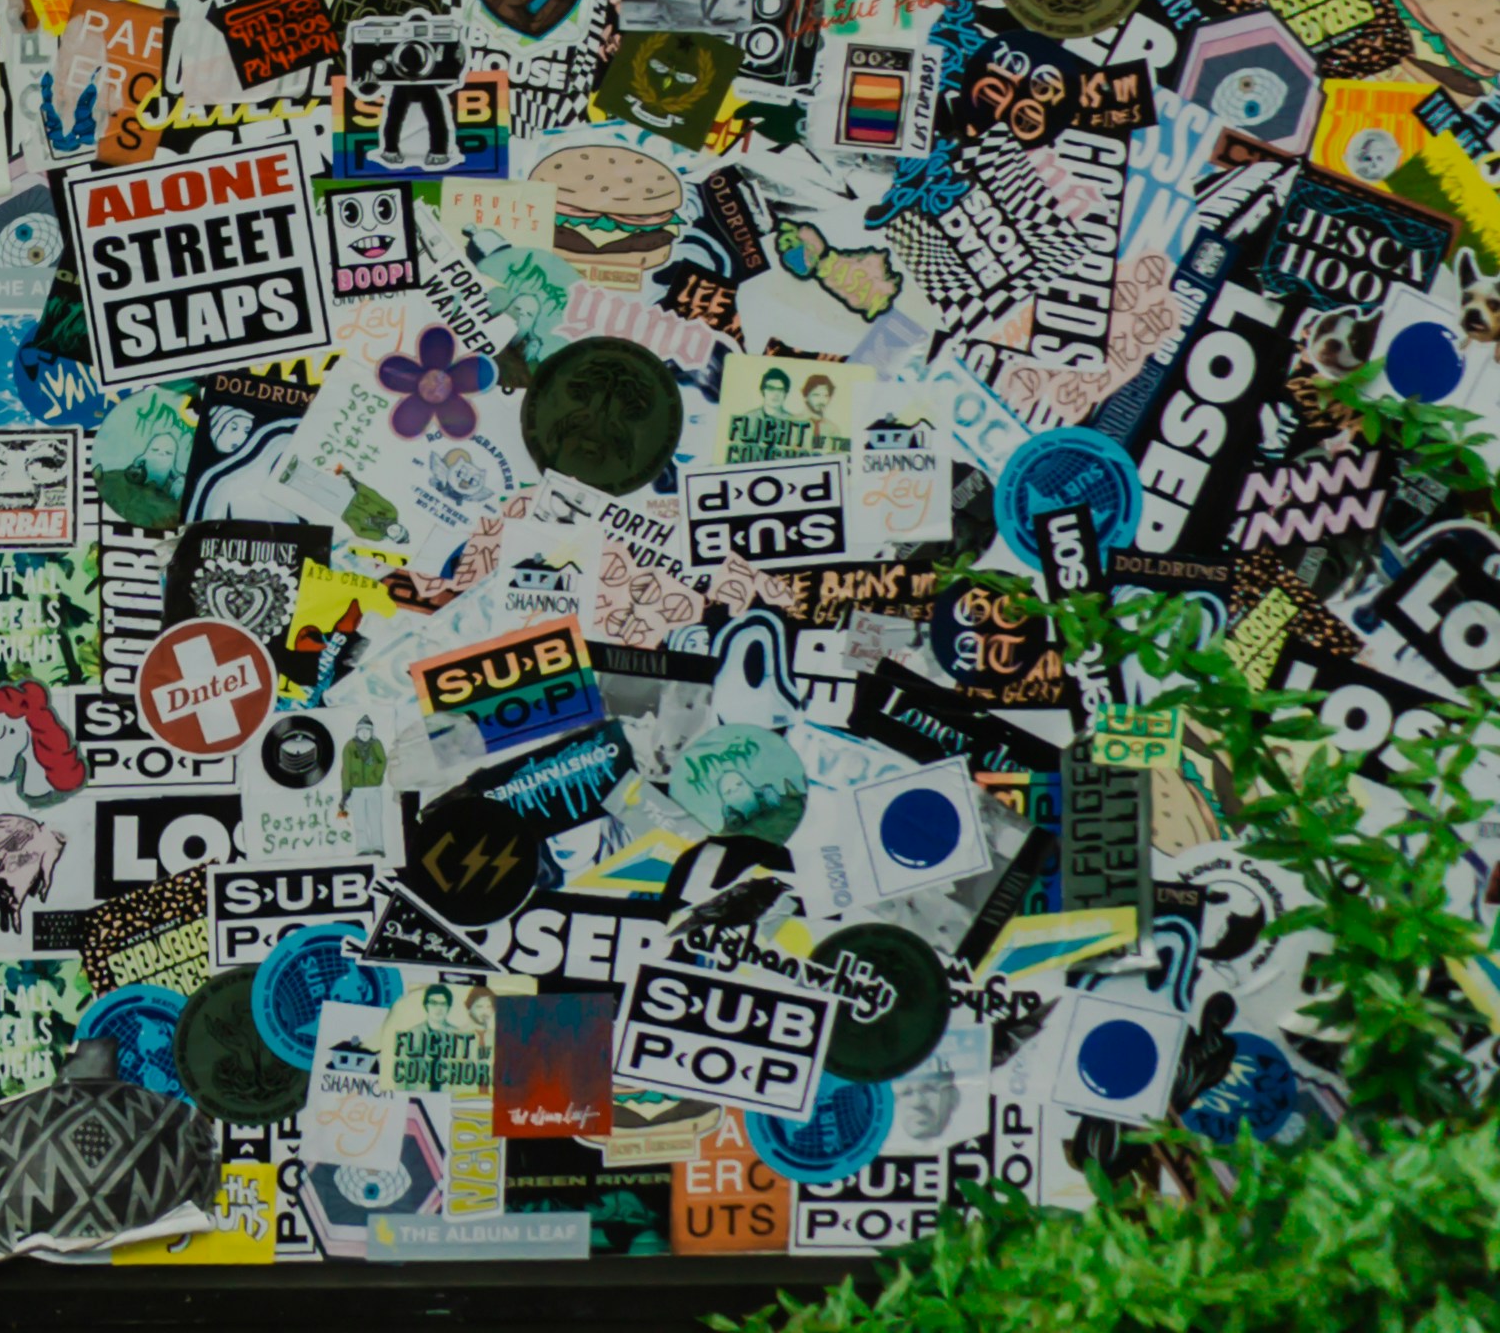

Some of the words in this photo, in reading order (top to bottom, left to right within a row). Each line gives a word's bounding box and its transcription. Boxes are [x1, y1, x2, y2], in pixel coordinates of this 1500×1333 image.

[86, 154, 294, 228] ALONE
[97, 210, 294, 287] STREET
[116, 291, 300, 358] SLAPS
[166, 666, 249, 713] Dntel
